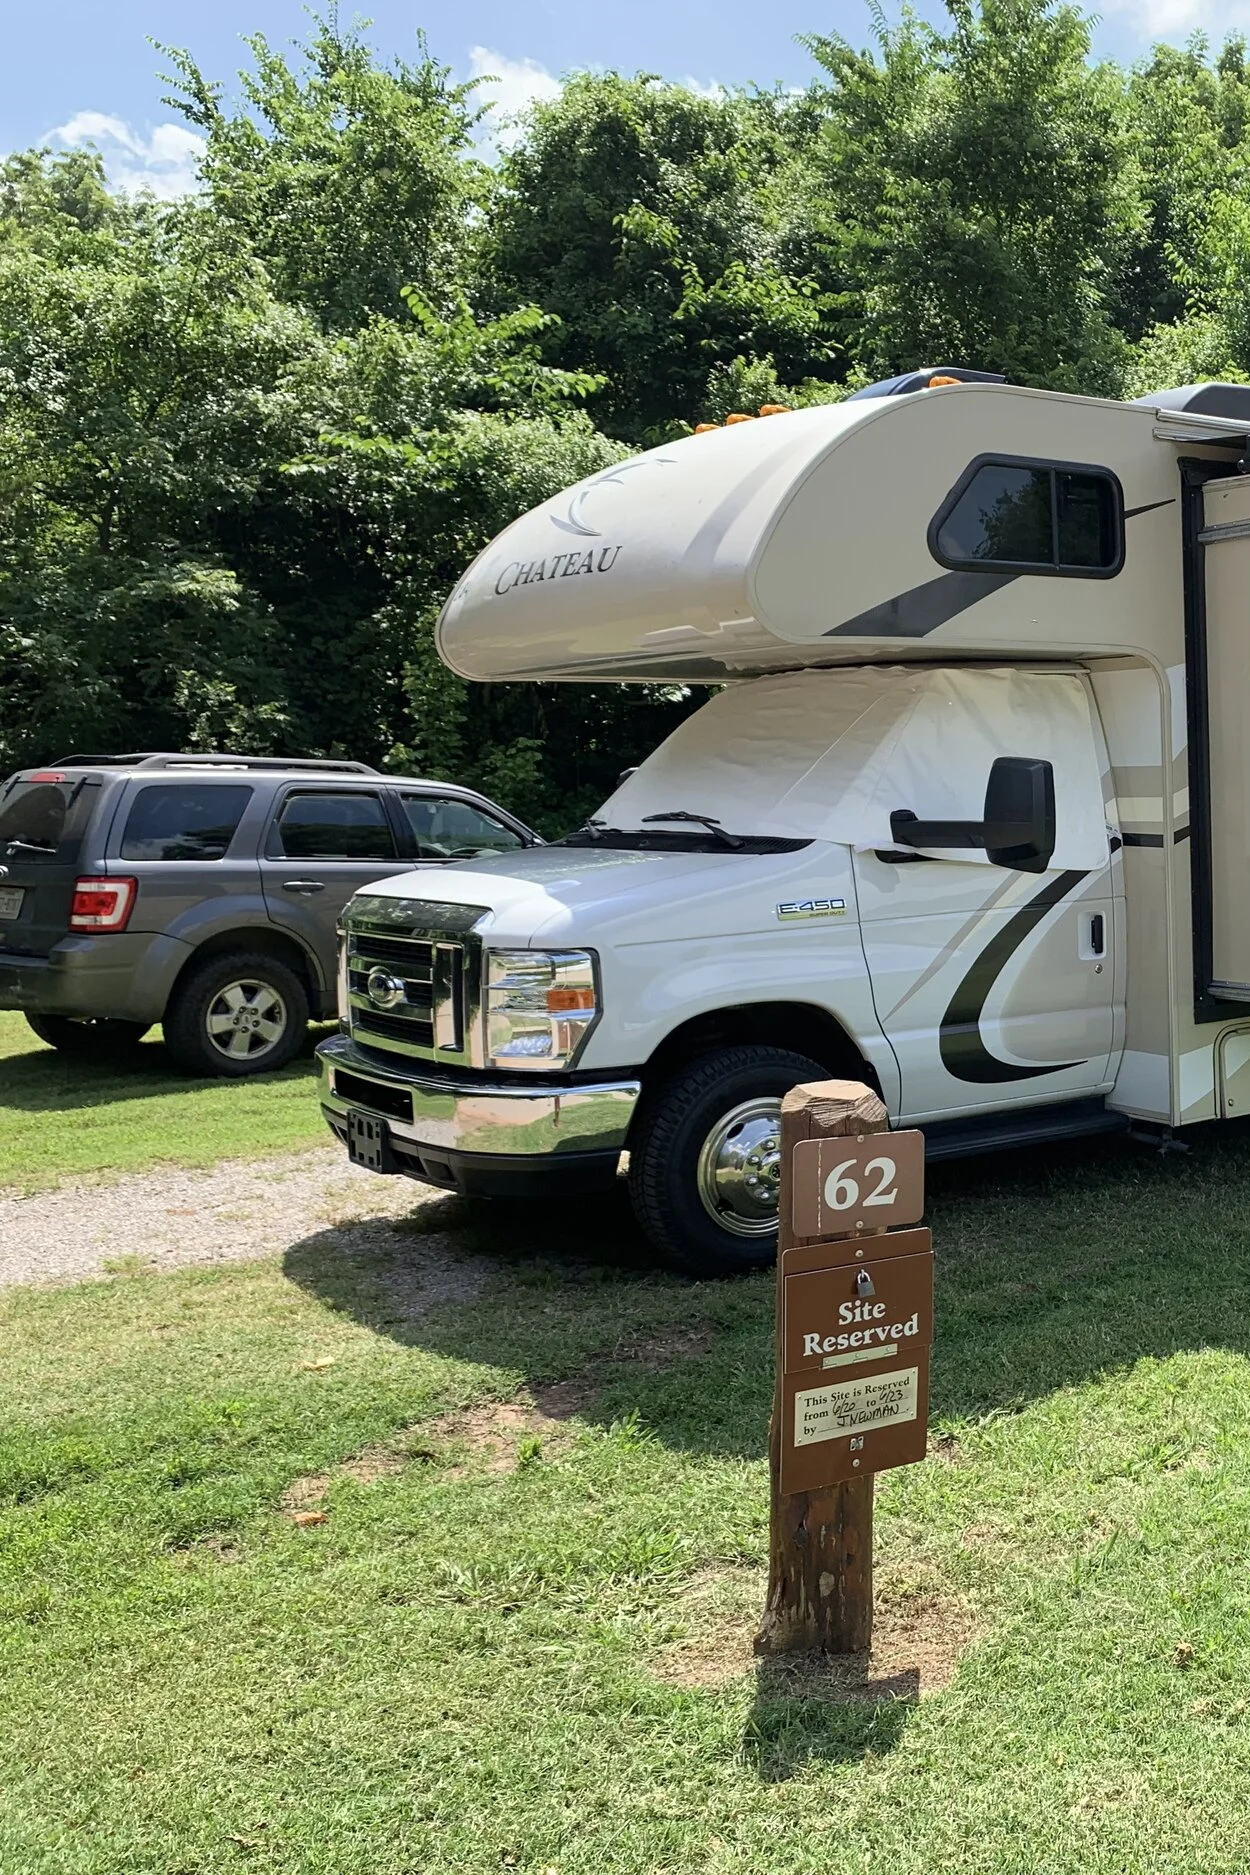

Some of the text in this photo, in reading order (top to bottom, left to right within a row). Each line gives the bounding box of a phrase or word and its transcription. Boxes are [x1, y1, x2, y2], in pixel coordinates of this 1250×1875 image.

[495, 546, 623, 595] CHATEAU
[824, 1156, 898, 1211] 62
[838, 1300, 886, 1326] Site
[802, 1313, 920, 1357] Reserved
[804, 1376, 910, 1407] This Site is Reserved
[804, 1410, 829, 1421] from
[866, 1399, 877, 1408] to
[803, 1426, 817, 1437] by
